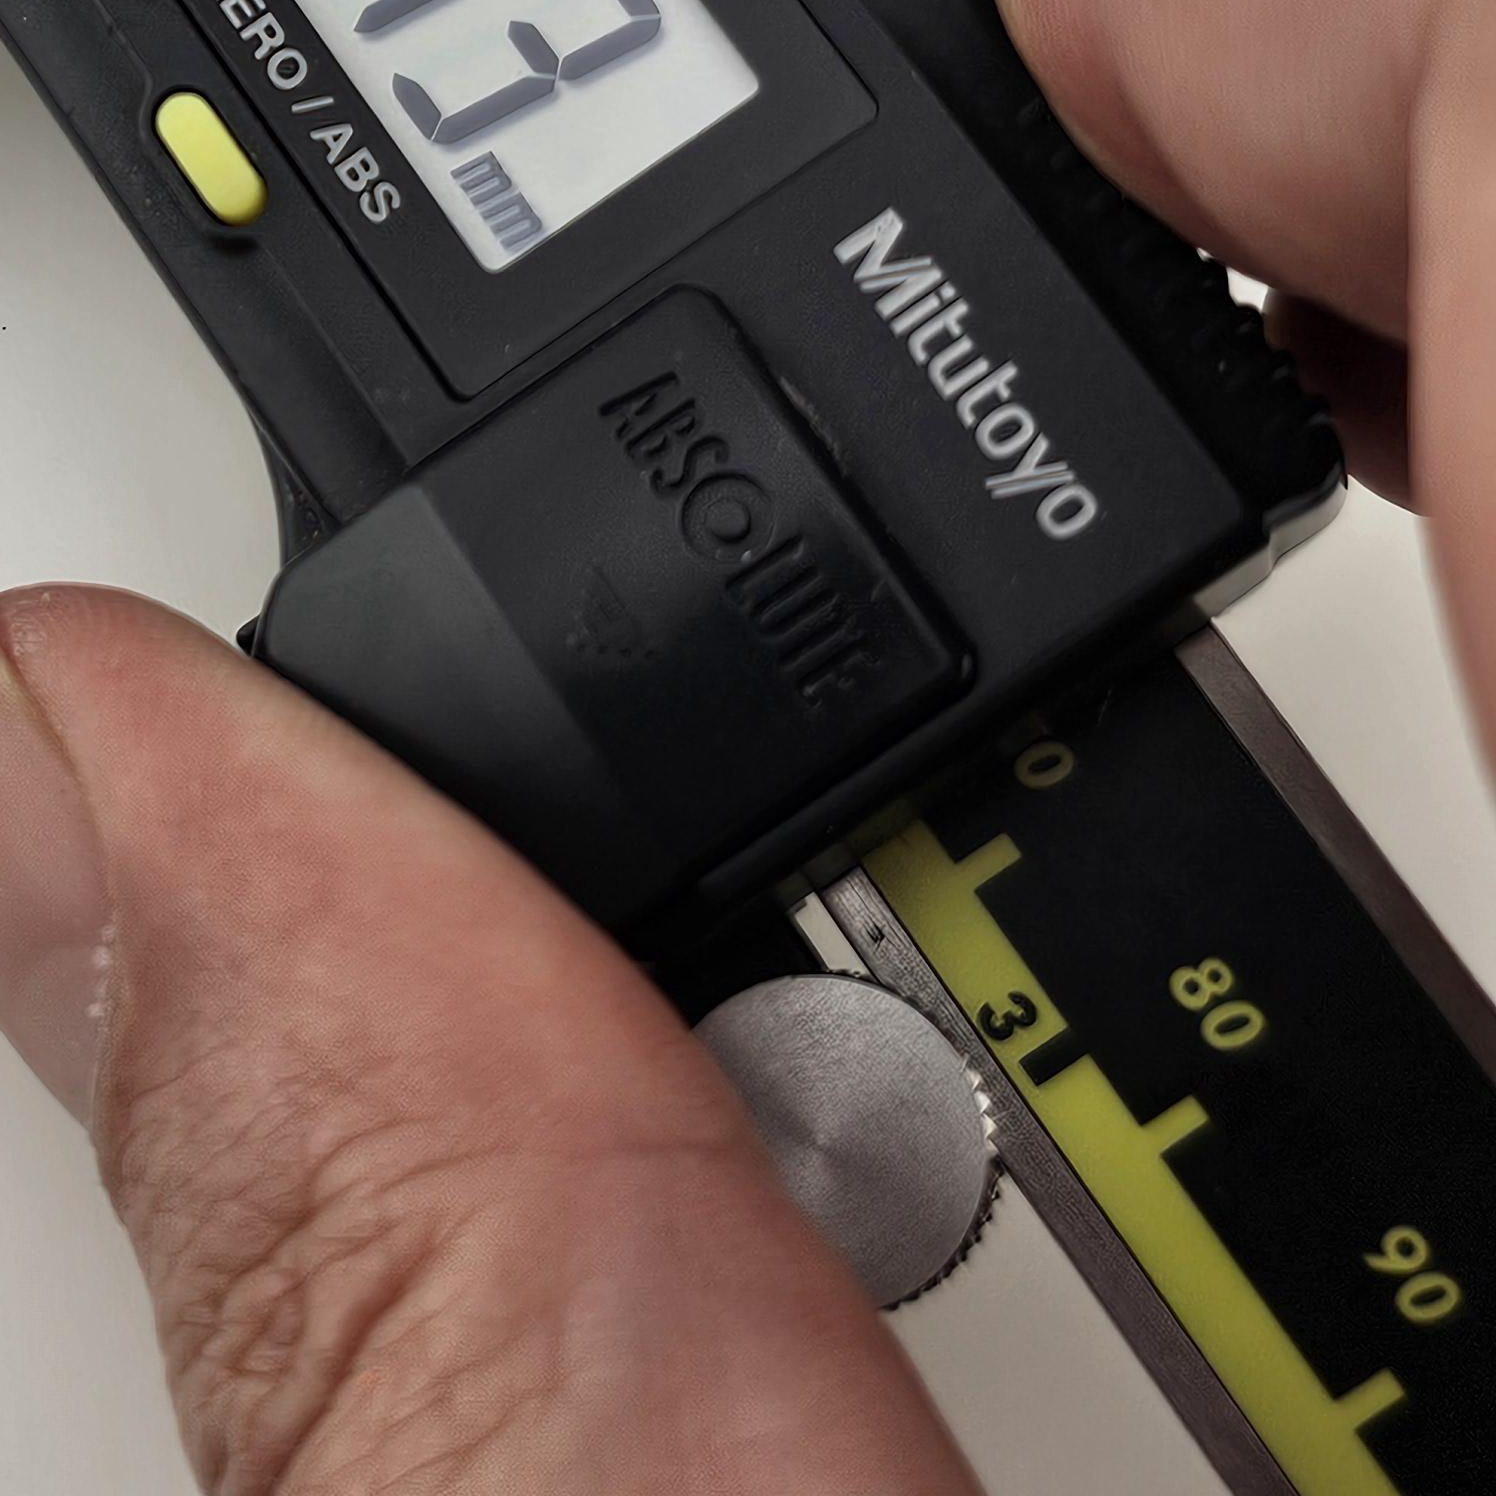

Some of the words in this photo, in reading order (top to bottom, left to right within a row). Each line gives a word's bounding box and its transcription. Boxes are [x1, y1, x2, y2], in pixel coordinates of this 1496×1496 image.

[309, 122, 402, 224] ABS
[450, 150, 545, 255] mm
[832, 205, 1099, 541] Mitutoyo
[598, 371, 882, 708] ABSOLUTE
[976, 991, 1038, 1042] 3
[1167, 955, 1267, 1052] 80
[1361, 1225, 1462, 1324] 90
